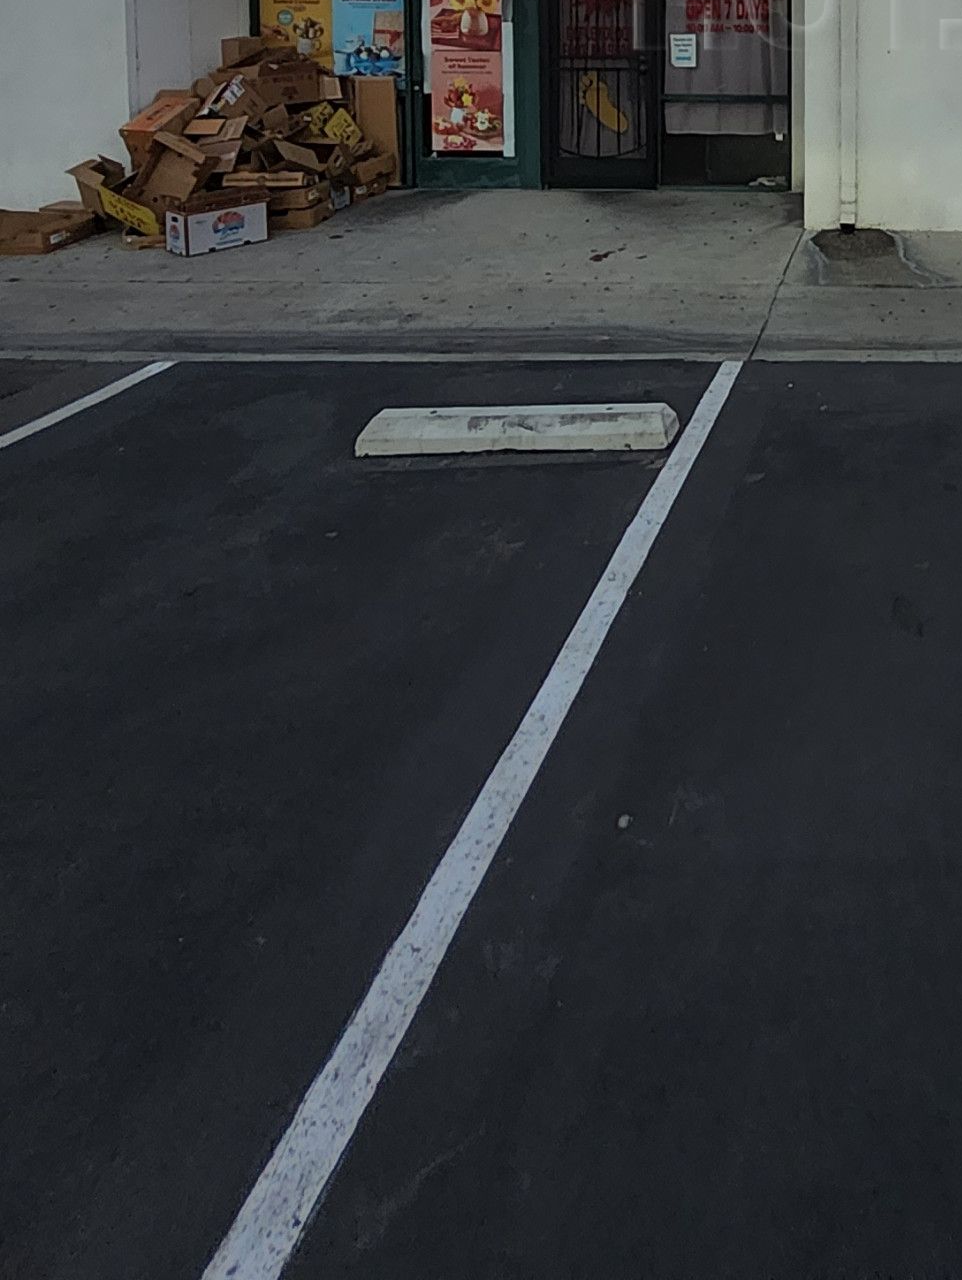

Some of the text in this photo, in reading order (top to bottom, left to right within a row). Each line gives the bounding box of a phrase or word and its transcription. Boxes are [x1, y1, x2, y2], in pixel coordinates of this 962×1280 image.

[686, 0, 770, 21] OPEN 7 DAYS
